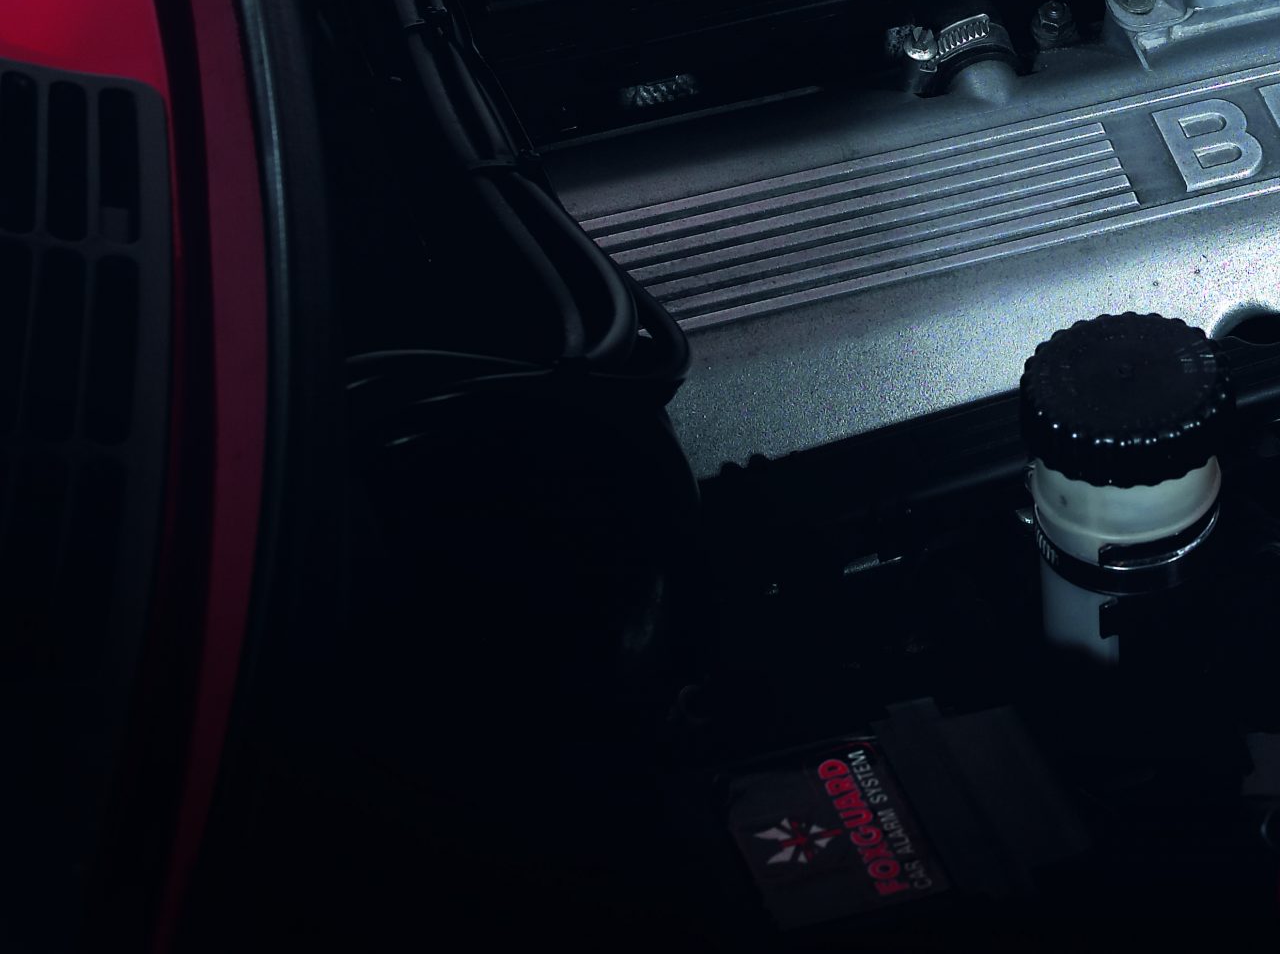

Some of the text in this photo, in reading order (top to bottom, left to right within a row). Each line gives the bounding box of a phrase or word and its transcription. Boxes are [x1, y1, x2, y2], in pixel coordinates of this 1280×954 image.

[817, 758, 911, 896] FOXGUARD
[848, 749, 933, 890] CAR ALARM SYSTEM
